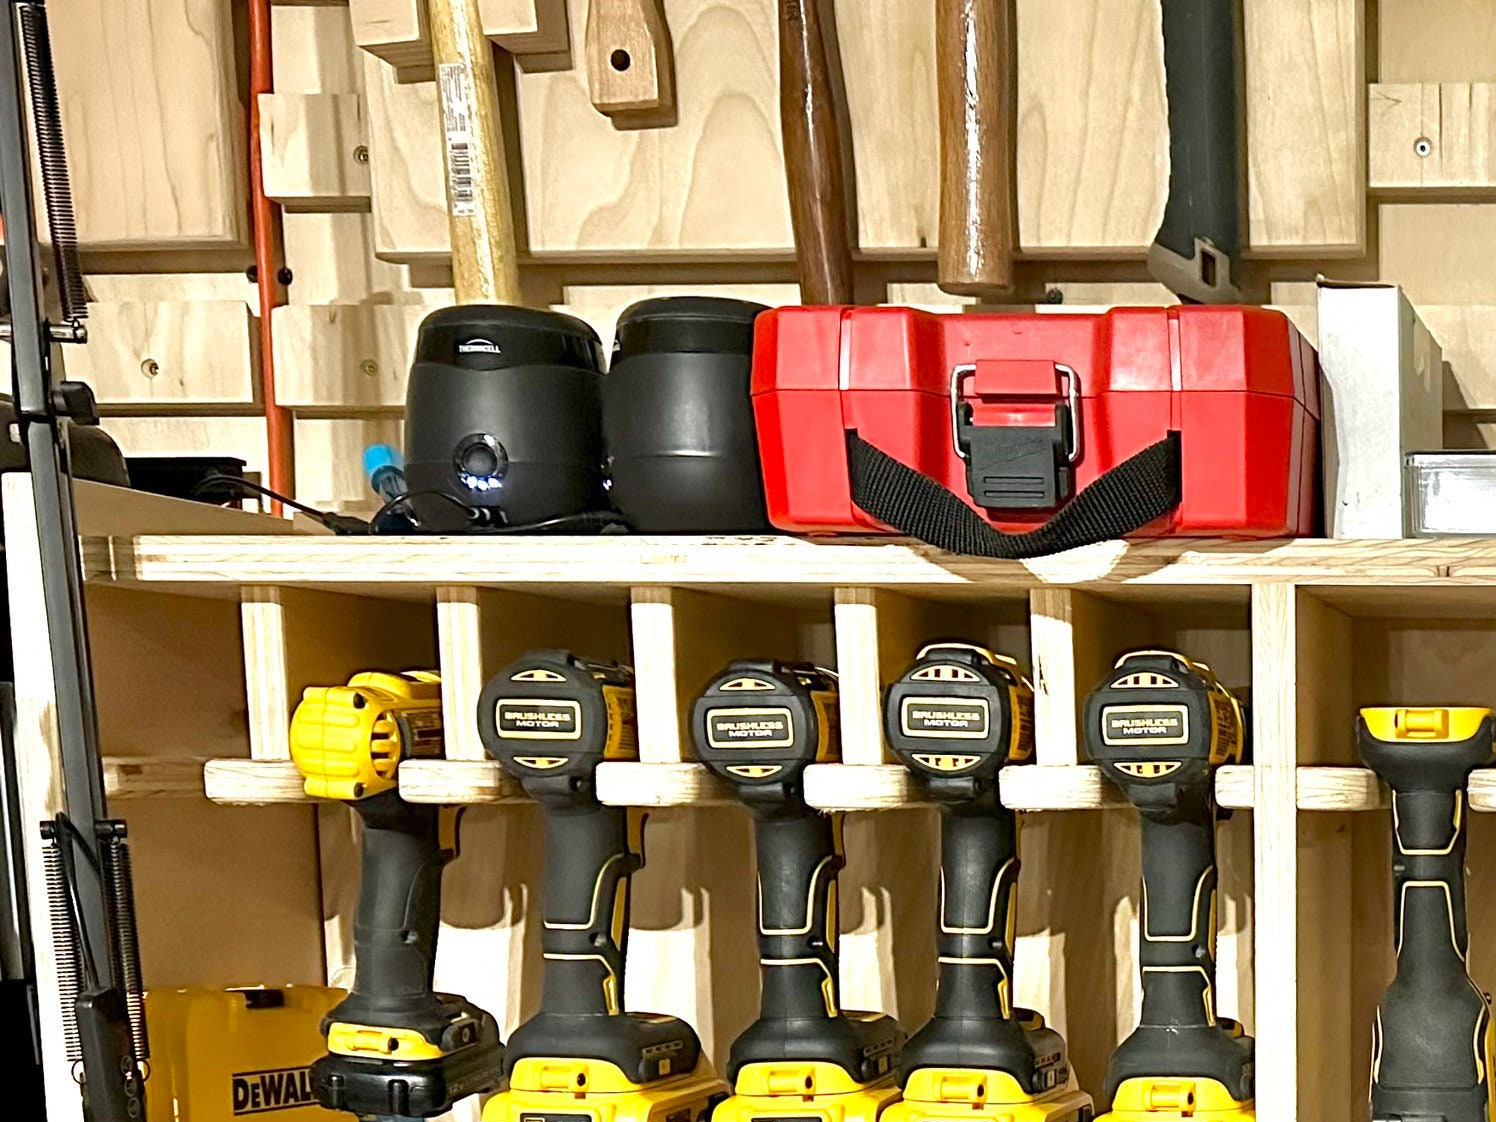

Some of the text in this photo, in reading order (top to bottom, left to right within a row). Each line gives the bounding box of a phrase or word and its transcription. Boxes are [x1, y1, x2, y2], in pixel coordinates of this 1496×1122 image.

[504, 712, 571, 722] BRUSHLESS
[912, 710, 980, 721] BRUSHLESS
[516, 720, 560, 728] MOTOR
[717, 721, 783, 731] BRUSHLESS
[923, 719, 969, 727] MOTOR
[1111, 718, 1178, 728] BRUSHLESS
[728, 729, 773, 737] MOTOR
[1123, 726, 1167, 734] MOTOR
[233, 1071, 312, 1110] DEWAL
